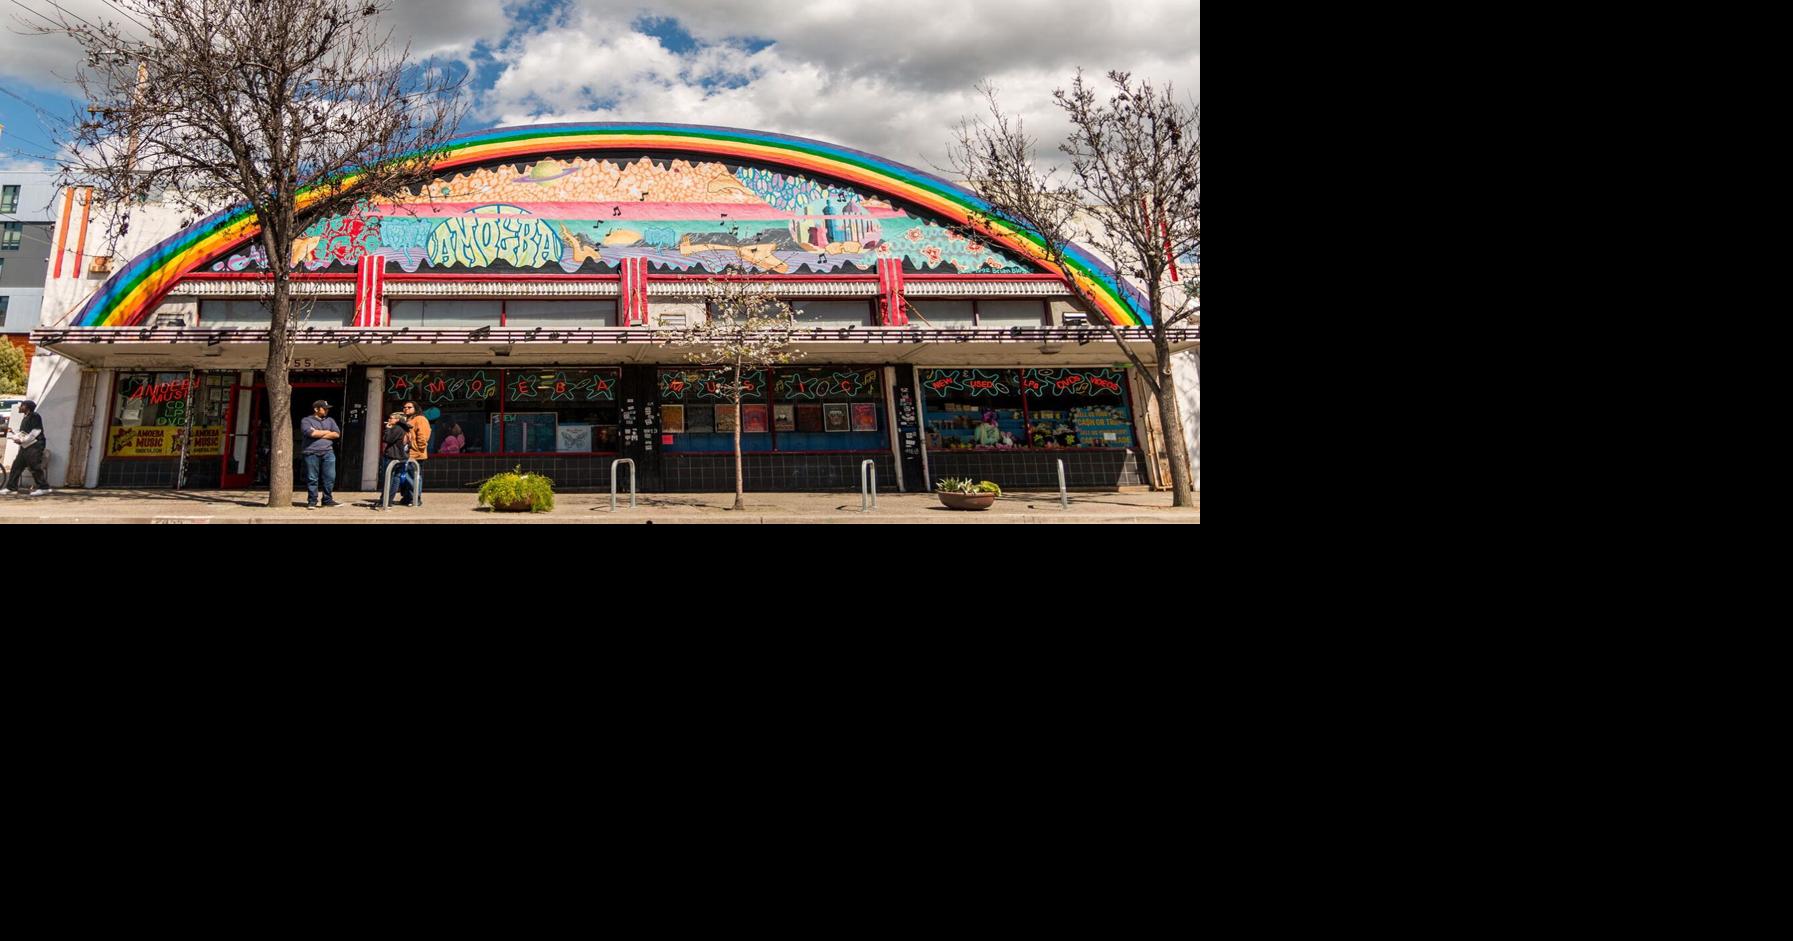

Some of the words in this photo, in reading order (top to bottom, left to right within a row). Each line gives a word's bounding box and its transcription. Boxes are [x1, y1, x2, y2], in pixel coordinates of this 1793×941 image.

[432, 217, 562, 267] AMOEBA
[932, 377, 953, 389] NEW
[970, 380, 993, 389] USED
[1090, 376, 1119, 391] VIDEOS
[150, 389, 195, 406] MUSI
[137, 429, 164, 437] AMOEBA
[195, 429, 219, 437] AMOEBA
[136, 437, 163, 448] MUSIC
[194, 437, 219, 447] MUSIC
